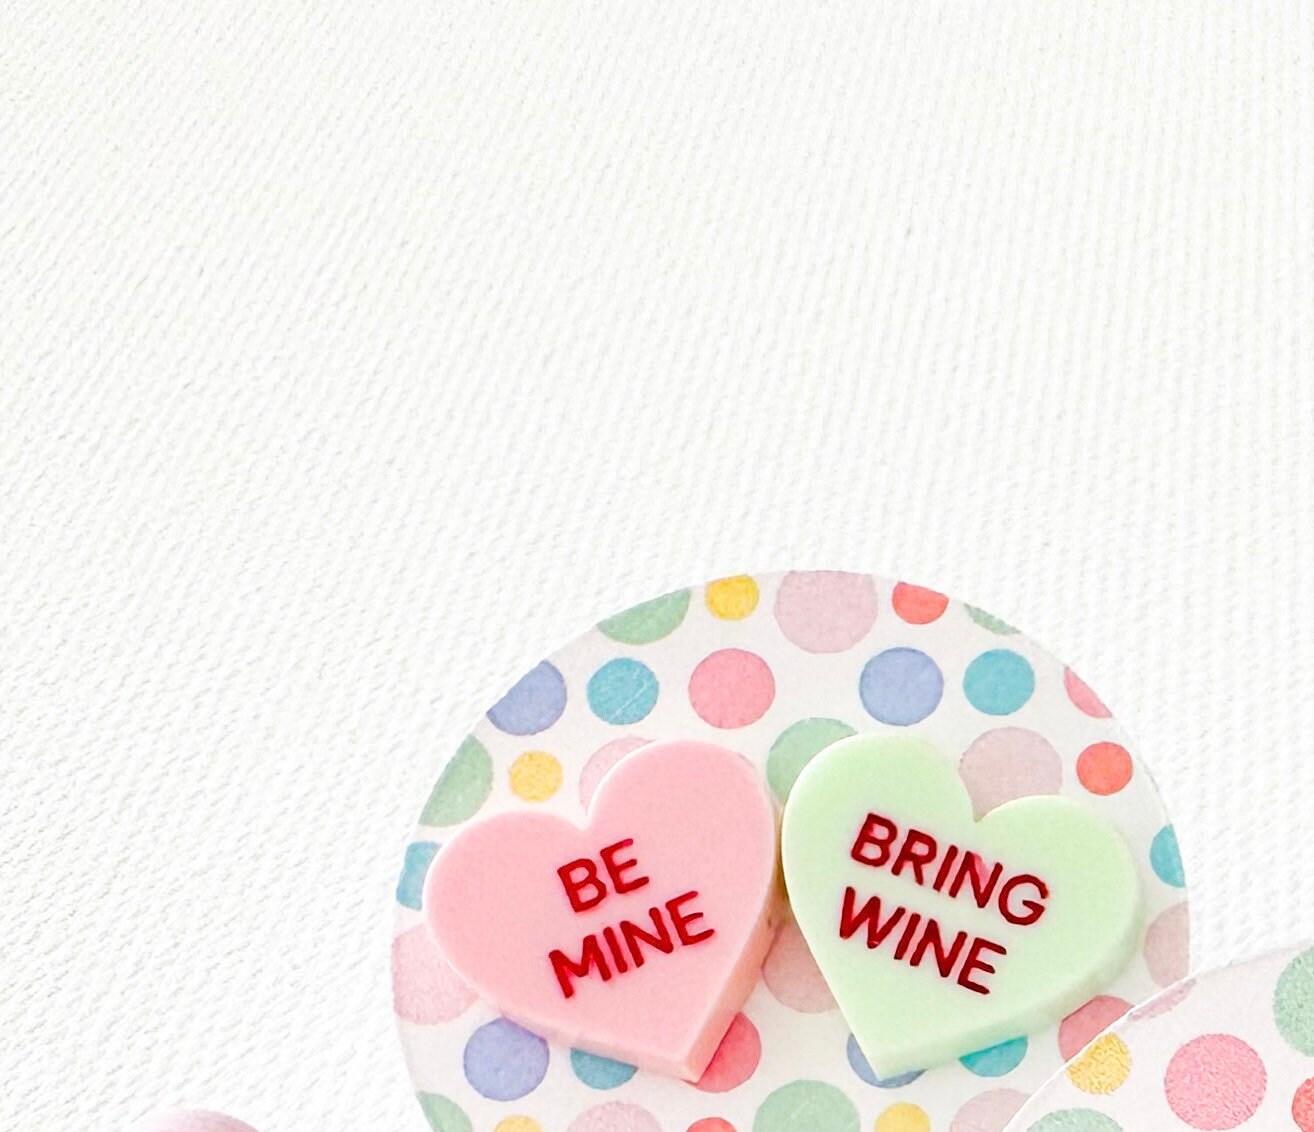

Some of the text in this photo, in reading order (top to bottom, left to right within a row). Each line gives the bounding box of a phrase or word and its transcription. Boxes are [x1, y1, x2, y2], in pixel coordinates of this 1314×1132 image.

[556, 838, 650, 914] BE
[850, 812, 1050, 926] BRING
[547, 890, 716, 1000] MINE
[839, 886, 1006, 995] WINE
